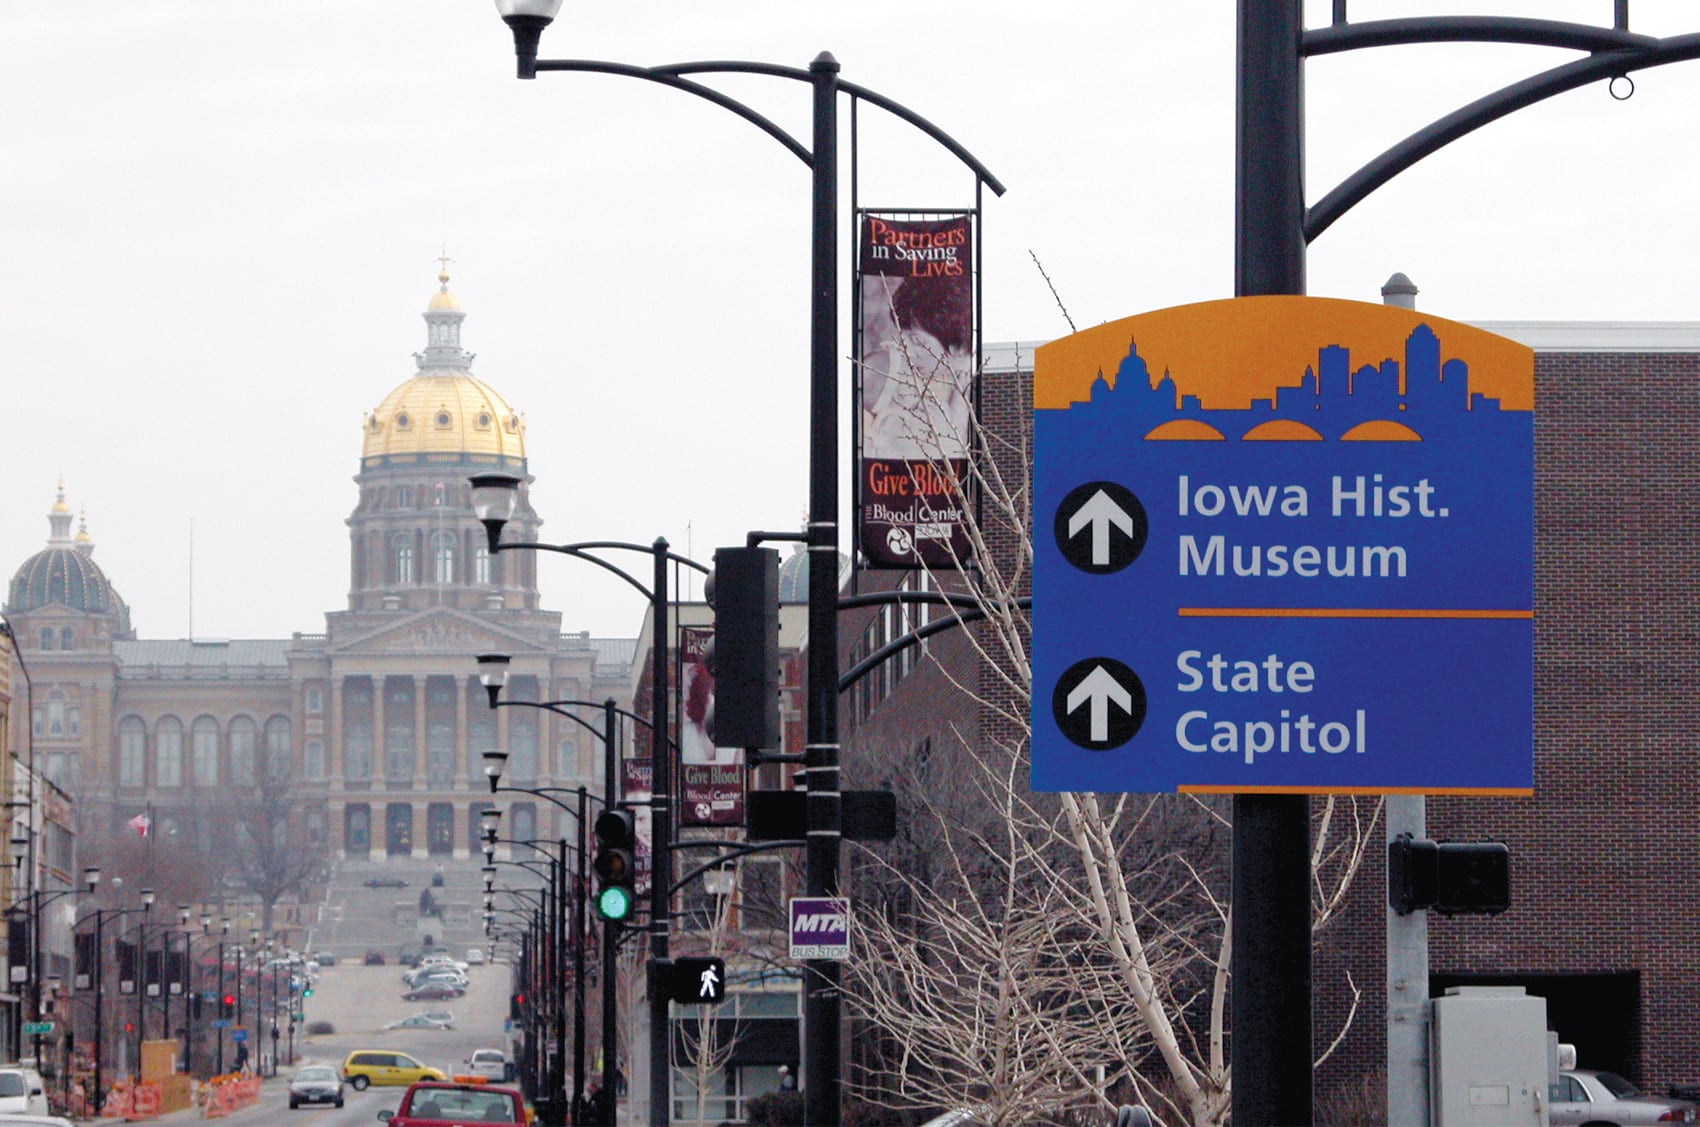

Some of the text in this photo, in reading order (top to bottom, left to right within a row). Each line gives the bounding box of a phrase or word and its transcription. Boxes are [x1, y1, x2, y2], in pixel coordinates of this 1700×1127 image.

[868, 219, 966, 249] Partners
[872, 241, 958, 267] in Saving
[910, 258, 964, 277] Lives
[869, 462, 908, 496] Give
[1178, 473, 1450, 518] Iowa Hist.
[873, 503, 914, 521] Blood
[918, 506, 963, 522] Center
[1178, 534, 1408, 578] Museum
[1176, 649, 1316, 693] State
[1175, 708, 1366, 764] Capitol
[685, 764, 740, 785] Give Blood
[686, 789, 742, 801] Blood Center
[794, 913, 847, 933] MTA
[791, 946, 849, 958] BUS STOP
